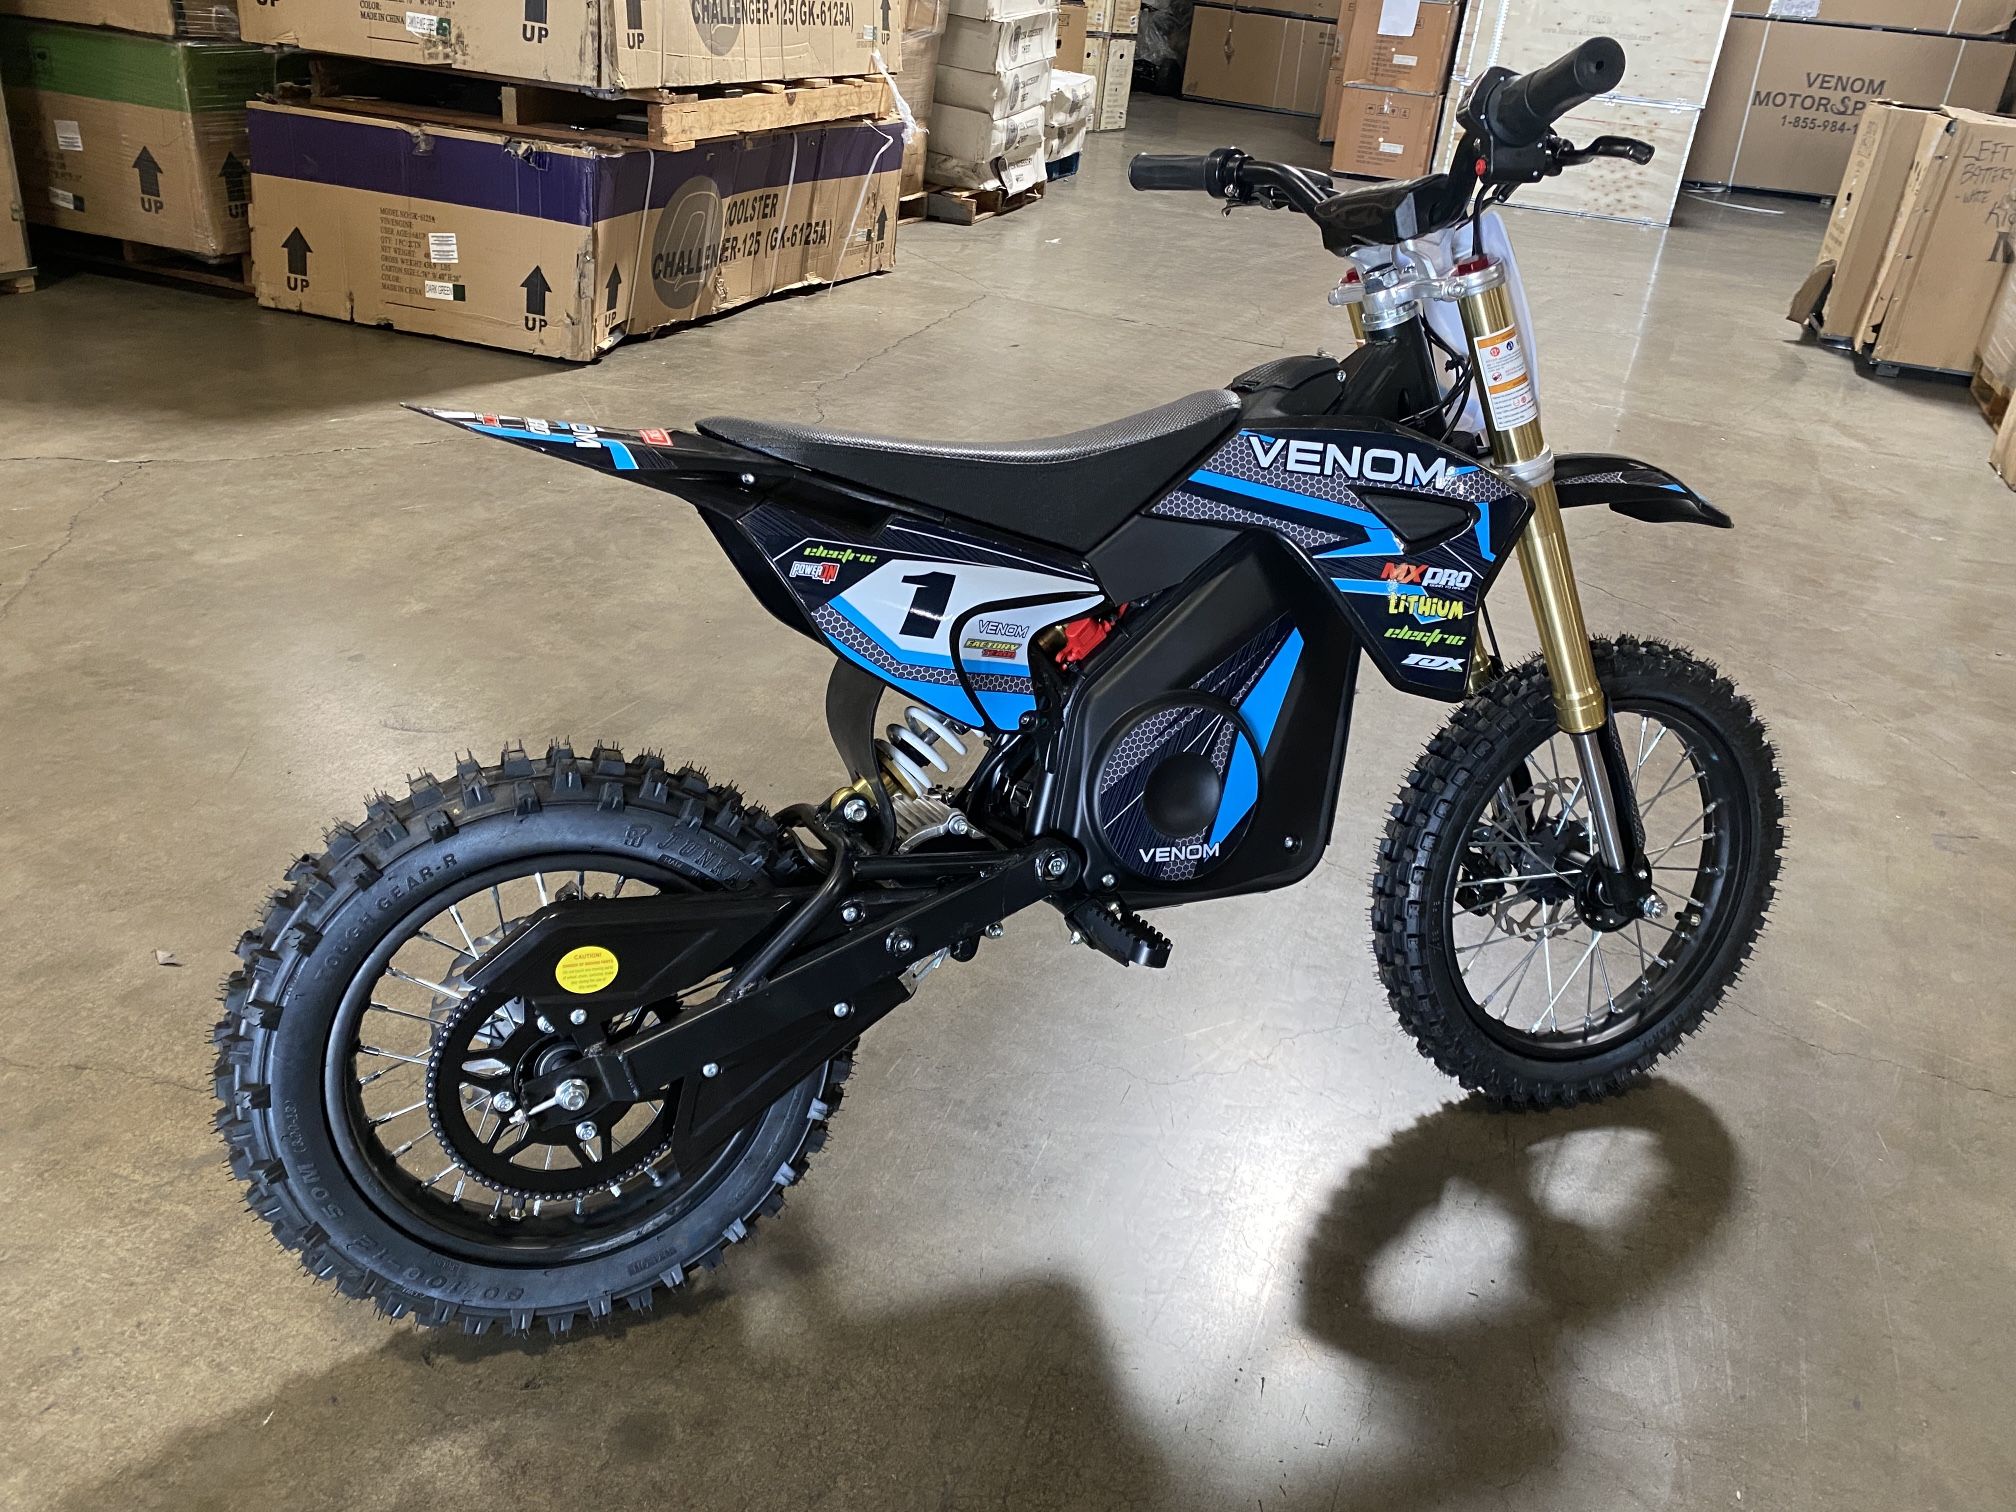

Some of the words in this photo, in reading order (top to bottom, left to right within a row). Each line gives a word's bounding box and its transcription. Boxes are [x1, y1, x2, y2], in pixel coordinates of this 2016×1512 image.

[360, 1, 381, 11] COLOR:
[360, 11, 378, 21] MADE
[386, 15, 405, 25] CHINA
[522, 24, 549, 44] UP
[626, 32, 645, 50] UP
[881, 32, 891, 46] UP
[1805, 72, 1887, 96] VENOM
[1751, 90, 1867, 116] MOTORSP
[1781, 114, 1859, 135] 1-855-984-1
[140, 197, 164, 214] UP
[765, 218, 833, 259] (GK-6125A)
[875, 241, 885, 255] UP
[287, 275, 310, 293] UP
[525, 315, 548, 333] UP
[604, 311, 617, 328] UP
[1249, 436, 1448, 489] VENOM
[899, 571, 957, 639] 1
[979, 620, 1030, 638] VENOM
[1383, 624, 1467, 648] electric
[965, 639, 1019, 650] FACTORY
[1139, 842, 1220, 862] VENOM
[376, 853, 458, 911] GEAR-R
